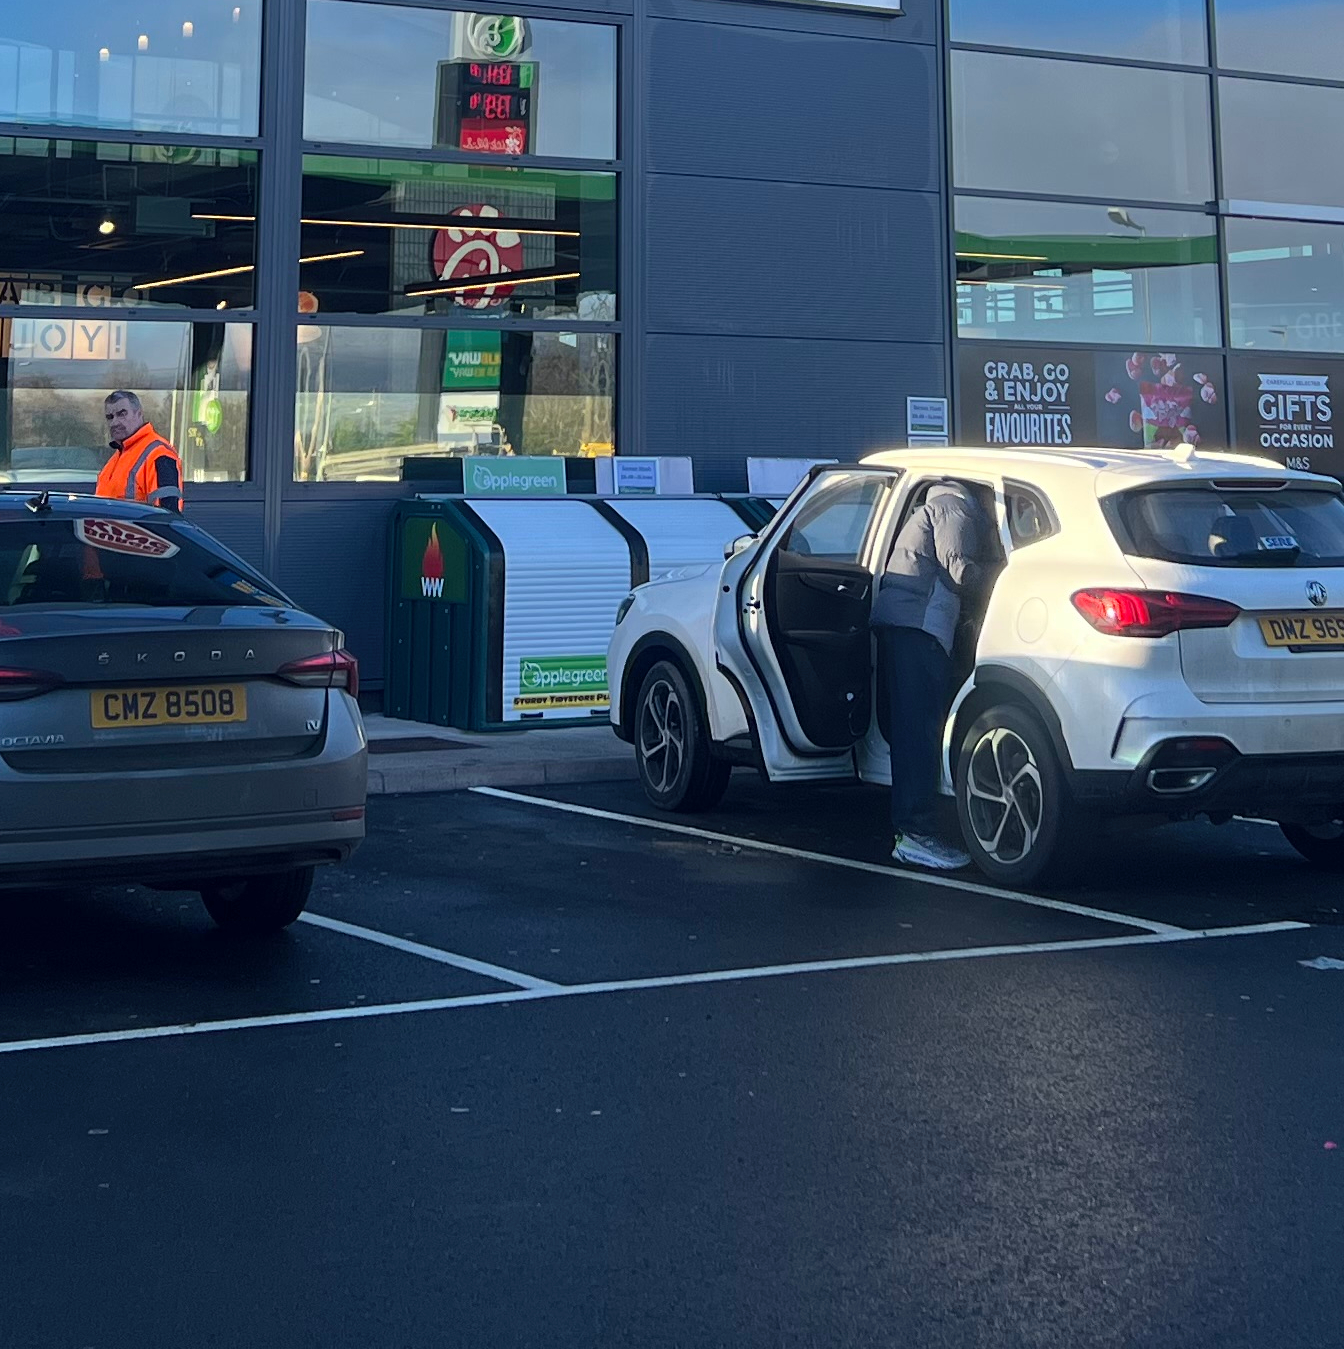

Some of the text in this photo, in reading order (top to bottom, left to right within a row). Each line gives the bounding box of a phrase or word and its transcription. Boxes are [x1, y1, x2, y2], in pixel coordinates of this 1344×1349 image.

[984, 361, 1069, 382] GRAB, GO
[984, 380, 1069, 402] & ENJOY
[1258, 393, 1332, 422] GIFTS
[985, 412, 1072, 444] FAVOURITES
[1260, 432, 1334, 448] OCCASION
[1286, 456, 1310, 469] M&S
[482, 471, 558, 490] applegreen
[1267, 617, 1311, 640] DMZ
[103, 688, 234, 721] CMZ 8508
[1, 733, 65, 747] OCTAVIA
